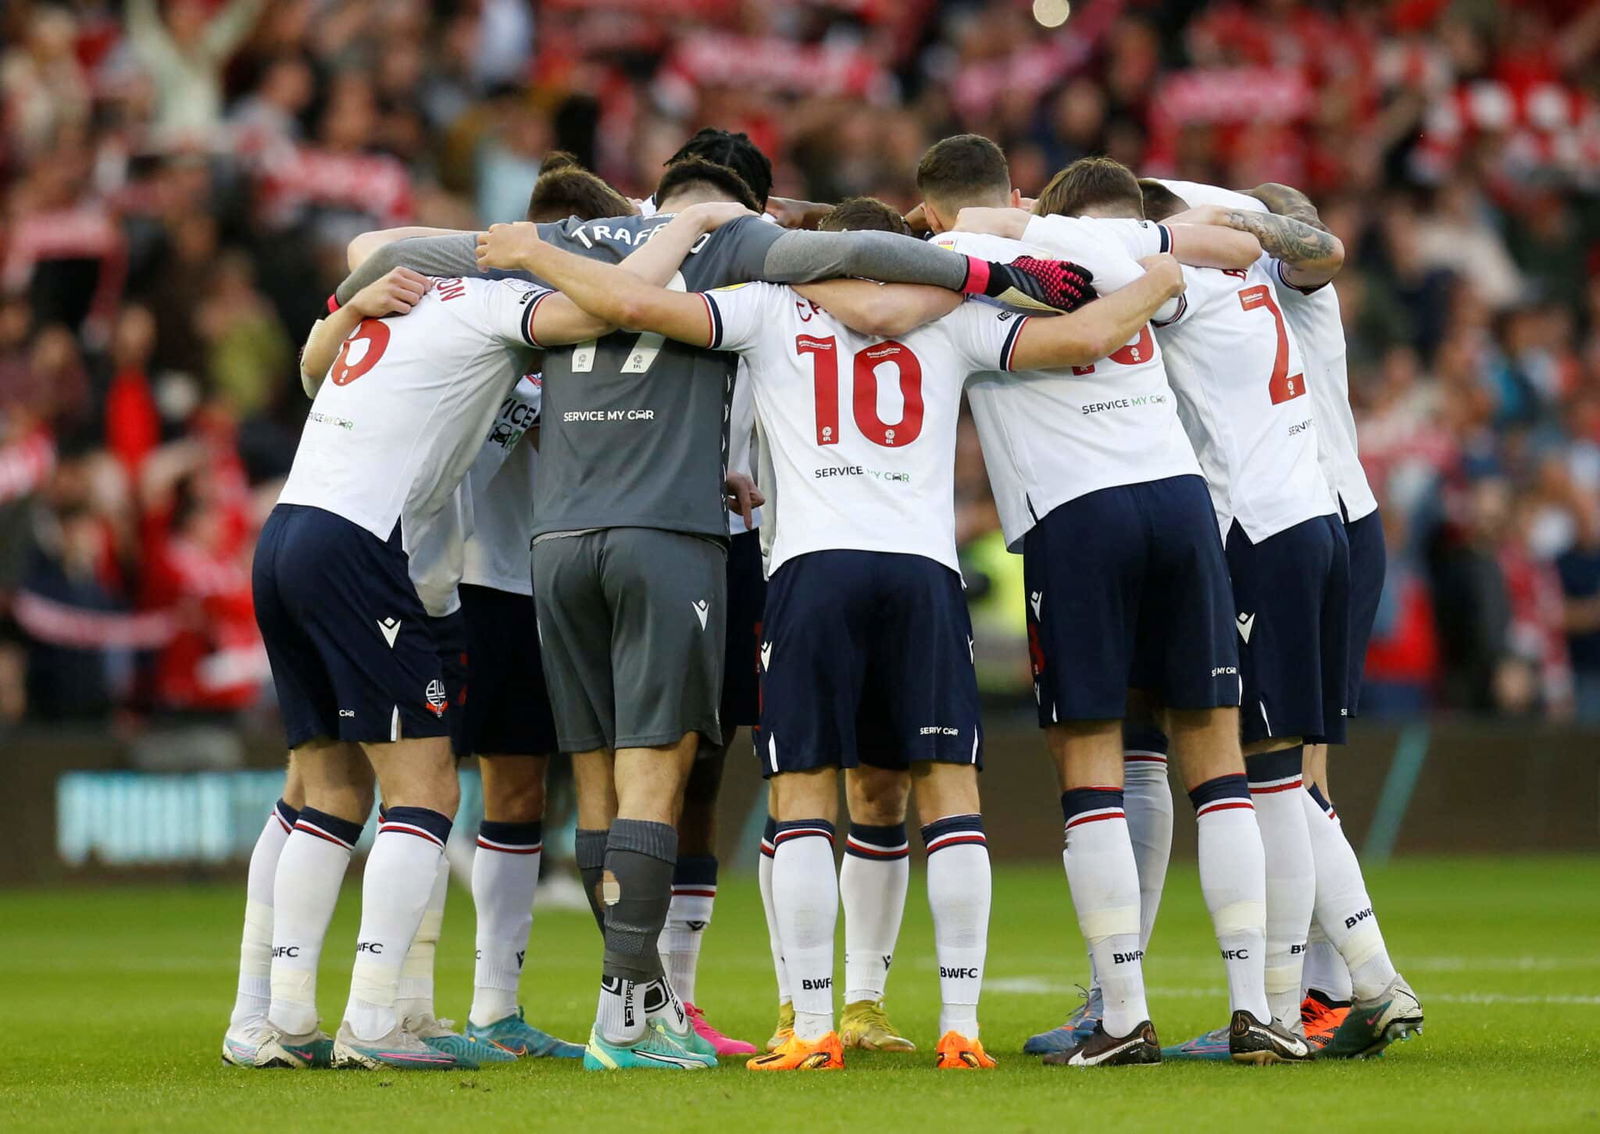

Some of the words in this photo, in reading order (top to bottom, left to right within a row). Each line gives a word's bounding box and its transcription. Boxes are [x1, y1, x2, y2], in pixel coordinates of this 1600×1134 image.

[1238, 284, 1307, 406] 2
[796, 333, 925, 448] 10
[1082, 399, 1130, 415] SERVICE
[1131, 396, 1147, 406] MY
[563, 411, 605, 422] SERVICE
[607, 410, 625, 420] MY
[814, 465, 864, 479] SERVICE
[1344, 907, 1374, 929] BWF
[271, 946, 300, 958] WFC
[1220, 948, 1249, 960] WFC
[940, 966, 978, 979] BWFC
[802, 977, 833, 990] BWF
